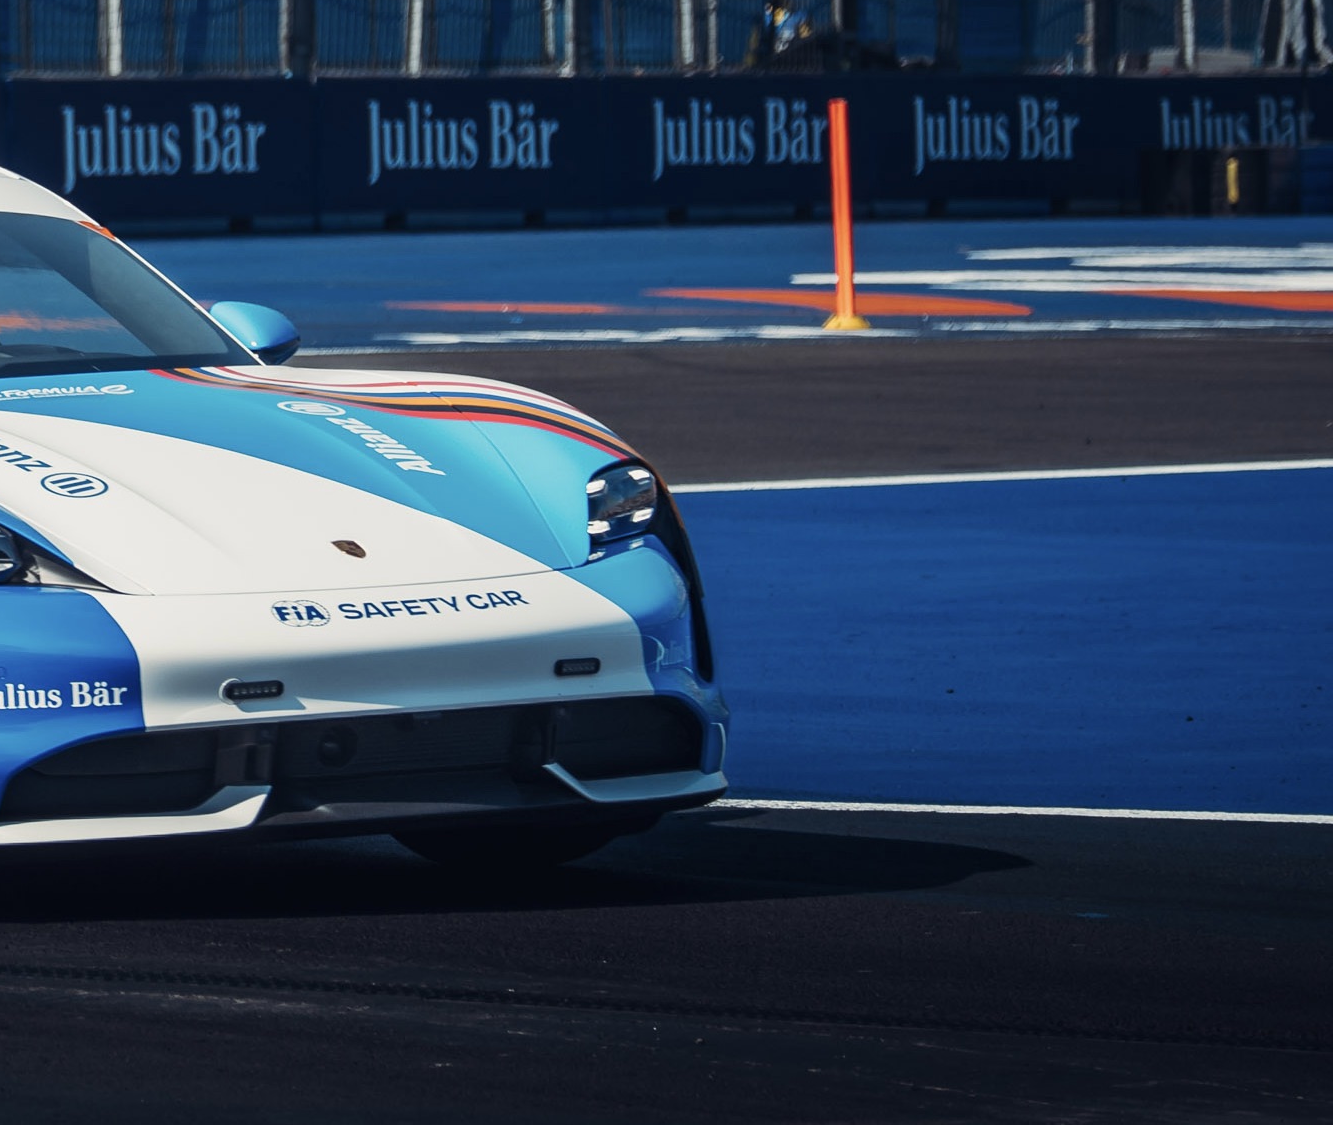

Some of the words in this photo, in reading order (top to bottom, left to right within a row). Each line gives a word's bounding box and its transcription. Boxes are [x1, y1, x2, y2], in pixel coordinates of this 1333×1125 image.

[61, 103, 181, 195] Julius
[191, 101, 267, 174] Bär
[366, 97, 479, 186] Julius
[487, 98, 559, 170] Bär
[652, 97, 756, 182] Julius
[764, 97, 829, 165] Bär
[912, 95, 1011, 177] Julius
[1018, 95, 1080, 161] Bär
[1, 386, 101, 398] FORMULA
[325, 417, 446, 476] Allianz
[338, 596, 460, 619] SAFETY
[465, 590, 529, 610] CAR
[69, 681, 128, 708] Bär
